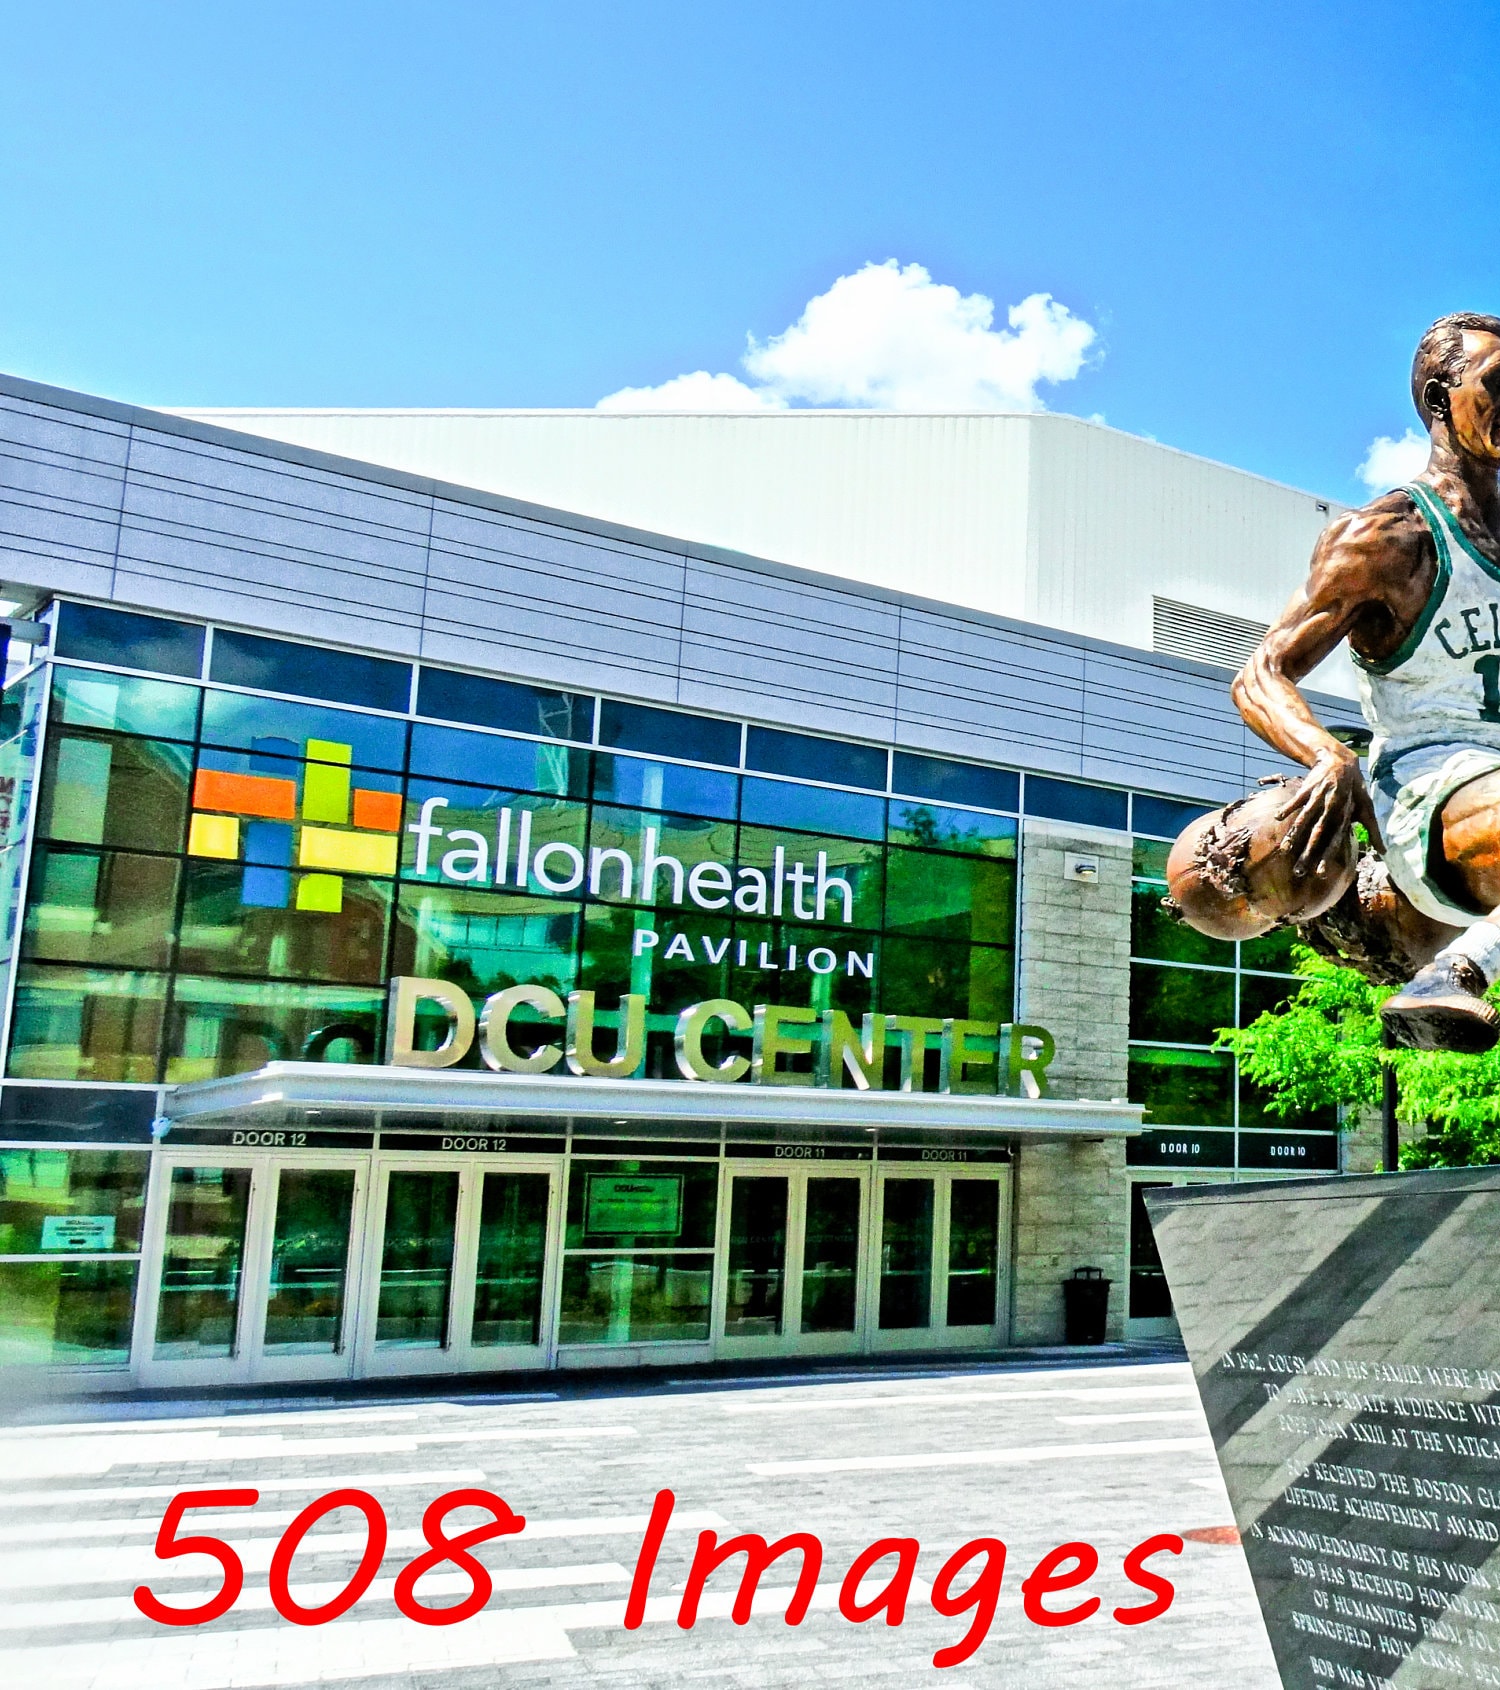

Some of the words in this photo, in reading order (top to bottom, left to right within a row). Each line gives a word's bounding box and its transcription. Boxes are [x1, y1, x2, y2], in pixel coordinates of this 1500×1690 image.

[408, 797, 854, 924] fallonhealth
[632, 928, 875, 979] PAVILION
[386, 975, 648, 1079] DCU
[674, 998, 1056, 1099] CENTER
[232, 1131, 286, 1146] DOOR
[290, 1133, 307, 1146] 12
[442, 1137, 489, 1151] DOOR
[492, 1139, 507, 1151] 12
[775, 1146, 812, 1158] DOOR
[815, 1148, 825, 1158] 11
[921, 1150, 955, 1161] DOOR
[958, 1151, 967, 1161] 11
[1160, 1142, 1188, 1154] DOOR
[1191, 1143, 1200, 1154] 10
[1270, 1146, 1296, 1156] DOOR
[1297, 1146, 1306, 1156] 10
[1222, 1352, 1235, 1368] IN
[1268, 1354, 1307, 1375] COUSY
[1313, 1359, 1340, 1377] AND
[1344, 1361, 1369, 1379] HIS
[1371, 1361, 1422, 1384] FAMILY
[1425, 1365, 1472, 1388] WERE
[1263, 1383, 1280, 1401] TO
[1394, 1397, 1468, 1422] AUDIENCE
[1391, 1428, 1409, 1448] AT
[1410, 1429, 1444, 1453] THE
[1313, 1462, 1377, 1489] RECEIVED
[1379, 1471, 1410, 1495] THE
[1412, 1477, 1473, 1505] BOSTON
[1284, 1486, 1340, 1513] LIFETIME
[1344, 1497, 1440, 1532] ACHIEVEMENT
[1446, 1515, 1499, 1542] AWARD
[1250, 1522, 1264, 1539] IN
[1267, 1525, 1388, 1567] ACKNOWLEDGMENT
[1391, 1549, 1410, 1571] OF
[1413, 1554, 1441, 1578] HIS
[1442, 1560, 1491, 1590] WORK
[1290, 1556, 1316, 1578] BOB
[1318, 1562, 1346, 1586] HAS
[1347, 1569, 1414, 1602] RECEIVED
[1417, 1586, 1500, 1623] HONORARY
[1313, 1589, 1329, 1610] OF
[1332, 1593, 1417, 1632] HUMANITIES
[1420, 1616, 1462, 1646] FROM
[1377, 1634, 1414, 1660] HOLY
[1310, 1655, 1335, 1679] BOB
[1337, 1663, 1365, 1688] WAS
